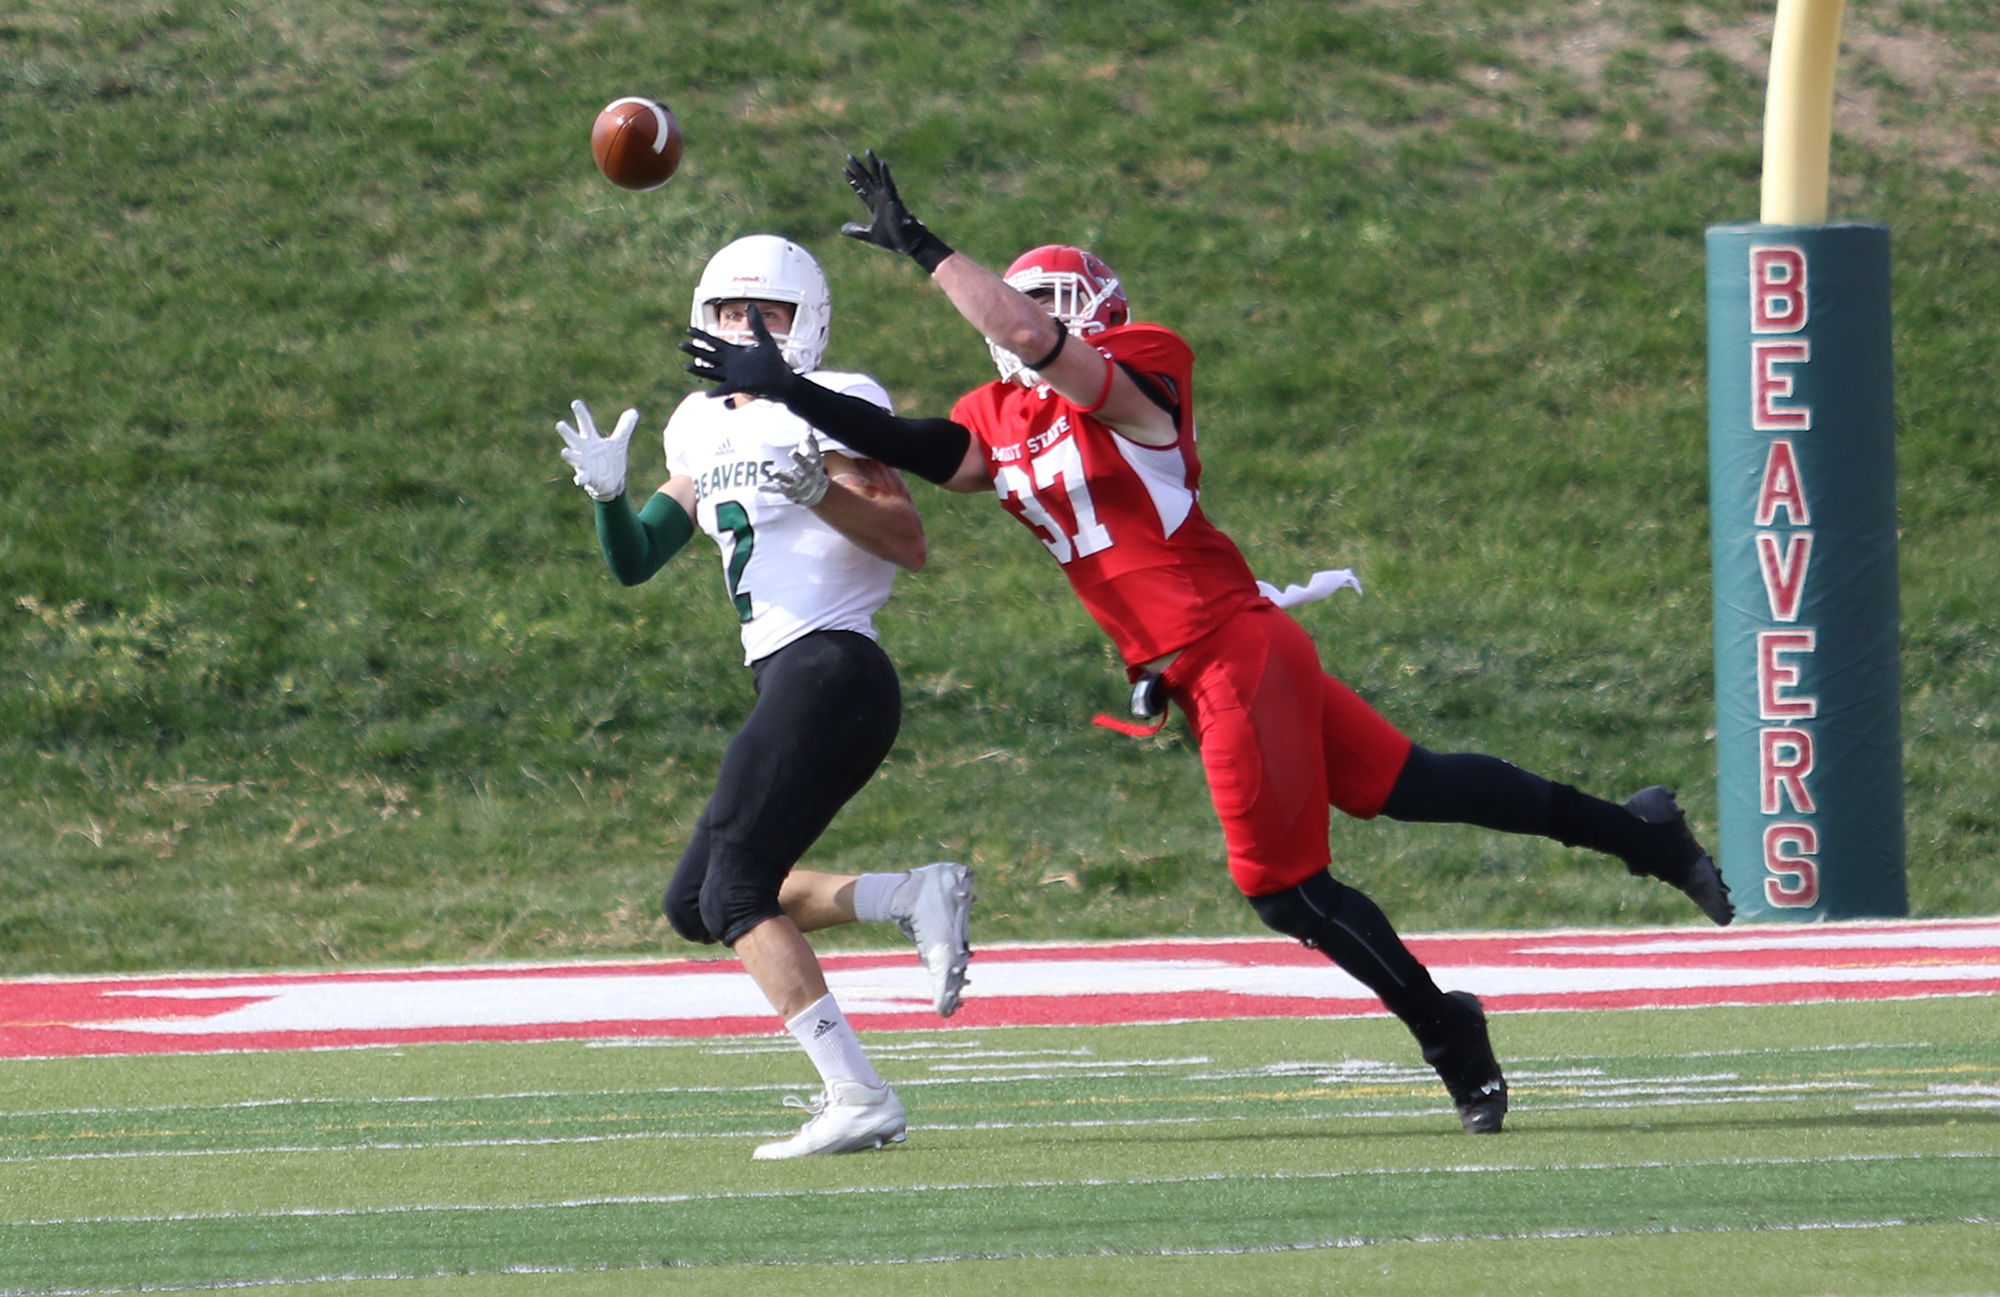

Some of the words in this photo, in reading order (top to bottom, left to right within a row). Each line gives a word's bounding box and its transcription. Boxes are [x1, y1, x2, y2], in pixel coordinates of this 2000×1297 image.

[1026, 415, 1071, 454] STATE
[715, 499, 754, 624] 2
[993, 435, 1115, 565] 37
[1749, 245, 1820, 908] BEAVERS
